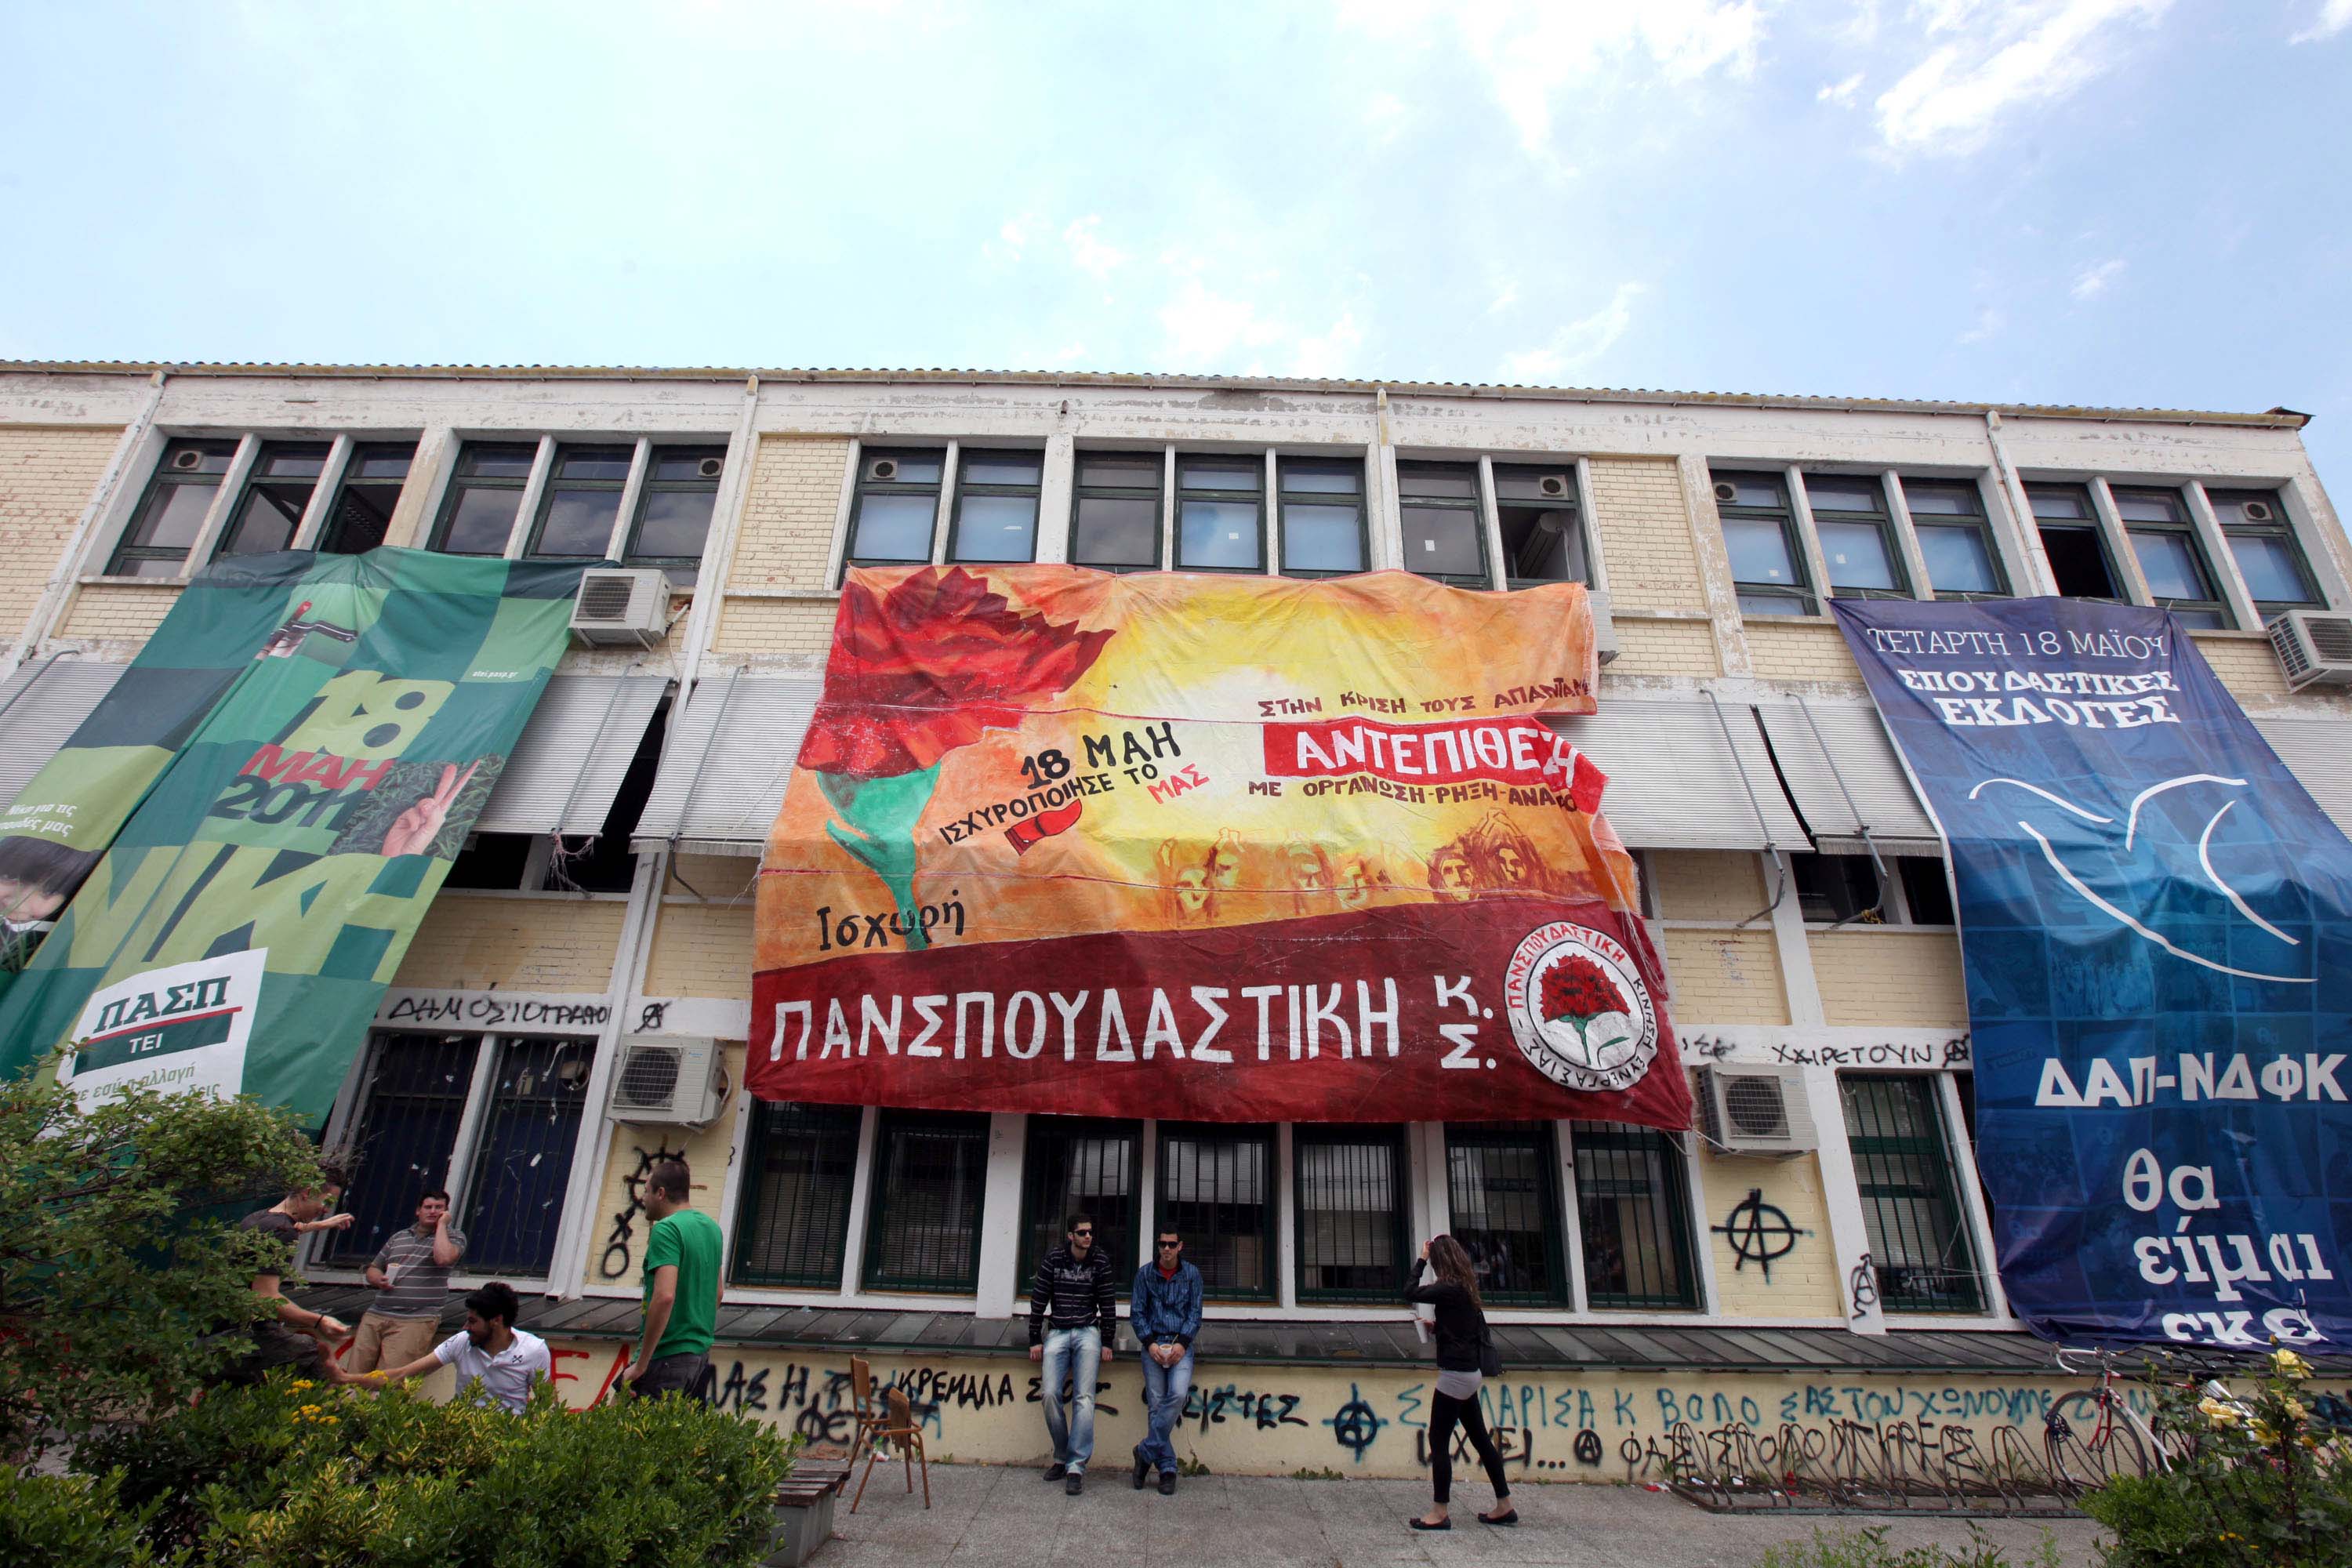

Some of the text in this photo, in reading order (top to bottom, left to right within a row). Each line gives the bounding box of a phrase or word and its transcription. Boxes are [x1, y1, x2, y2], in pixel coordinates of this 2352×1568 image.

[1867, 627, 2168, 659] ΤΕΤΑΡΤΗ 18 ΜΑΪΟΥ
[1258, 697, 1323, 717] ΣΤΗΝ
[1340, 691, 1406, 714] ΚΡΙΣΗ
[1420, 695, 1475, 713] ΤΟΥΣ
[1897, 669, 2180, 695] ΣΠΟΥΔΑΣΤΙΚΕΣ
[280, 670, 456, 760] 18
[1933, 695, 2181, 729] ΕΚΛΟΓΕΣ
[238, 743, 396, 790] ΜΑΗ
[1021, 721, 1181, 789] 18 ΜΑΗ
[206, 774, 371, 831] 2011
[939, 763, 1210, 845] ΙΣΧΥΡΟΠΟΙΗΣΕ ΤΟ ΜΑΣ
[1248, 782, 1282, 797] ΜΕ
[39, 820, 74, 837] μας
[817, 889, 965, 952] Ισχυρή
[1508, 924, 1625, 1010] ΠΑΝΣΠΟΥΔΑΣΤΙΚΗ
[93, 975, 231, 1034] ΠΑΣΠ
[770, 975, 1493, 1063] ΠΑΝΣΠΟΥΔΑΣΤΙΚΗ Κ.
[1633, 978, 1657, 1051] ΚΙΝΗΣΗ
[129, 1033, 163, 1054] ΤΕΙ
[1439, 1023, 1496, 1069] Σ.
[2034, 1051, 2350, 1107] ΔΑΠ-ΝΔΦΚ
[2122, 1147, 2220, 1211] θα
[2133, 1215, 2334, 1302] είμαι
